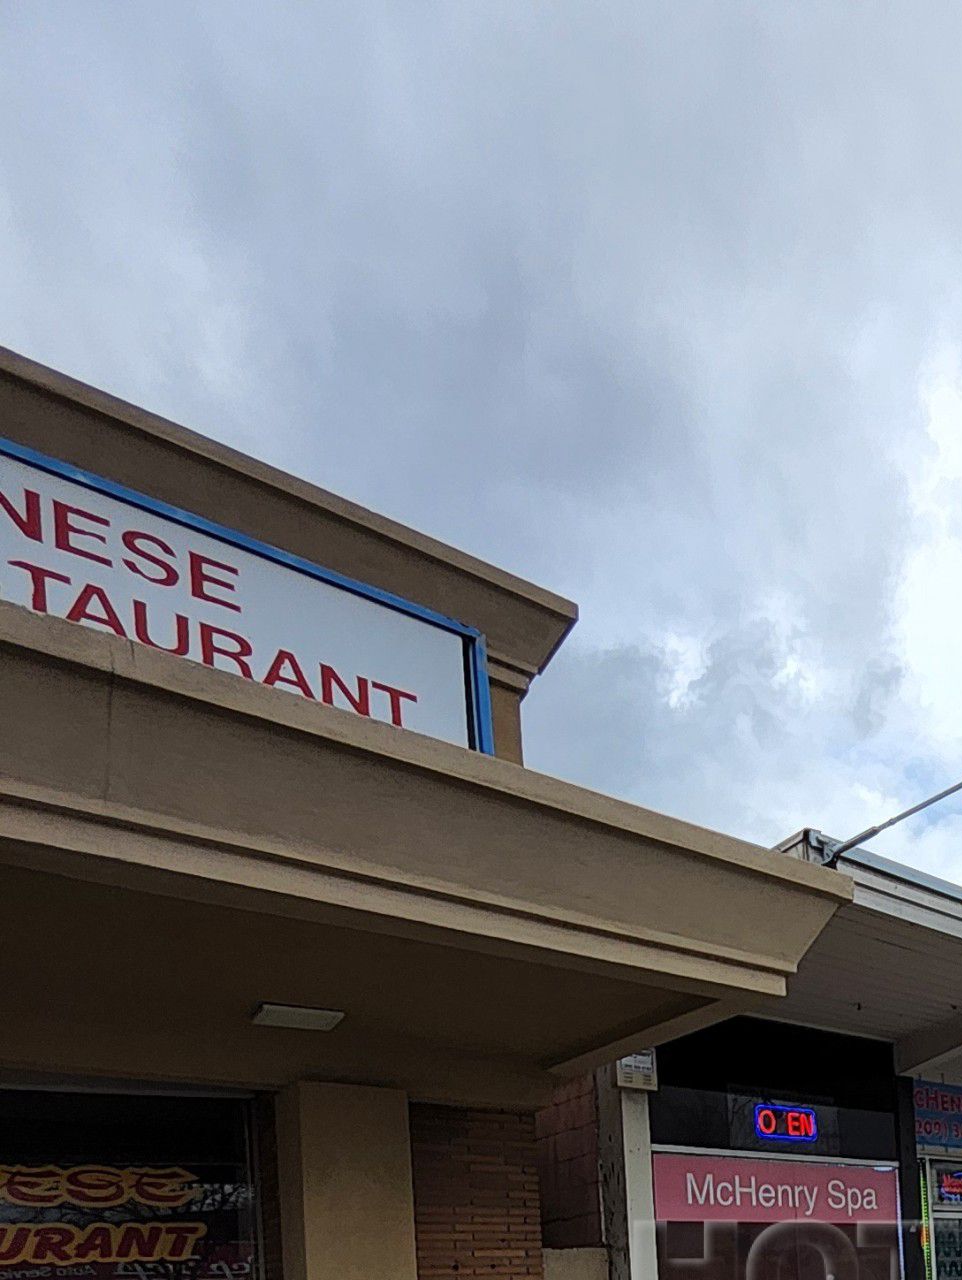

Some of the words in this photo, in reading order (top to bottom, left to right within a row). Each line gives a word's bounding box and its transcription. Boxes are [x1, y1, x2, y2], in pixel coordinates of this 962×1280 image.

[0, 487, 243, 613] NESE
[8, 559, 418, 729] TAURANT
[758, 1109, 814, 1137] OEN
[0, 1165, 198, 1207] ESE
[686, 1172, 818, 1216] McHenry
[827, 1179, 878, 1217] Spa
